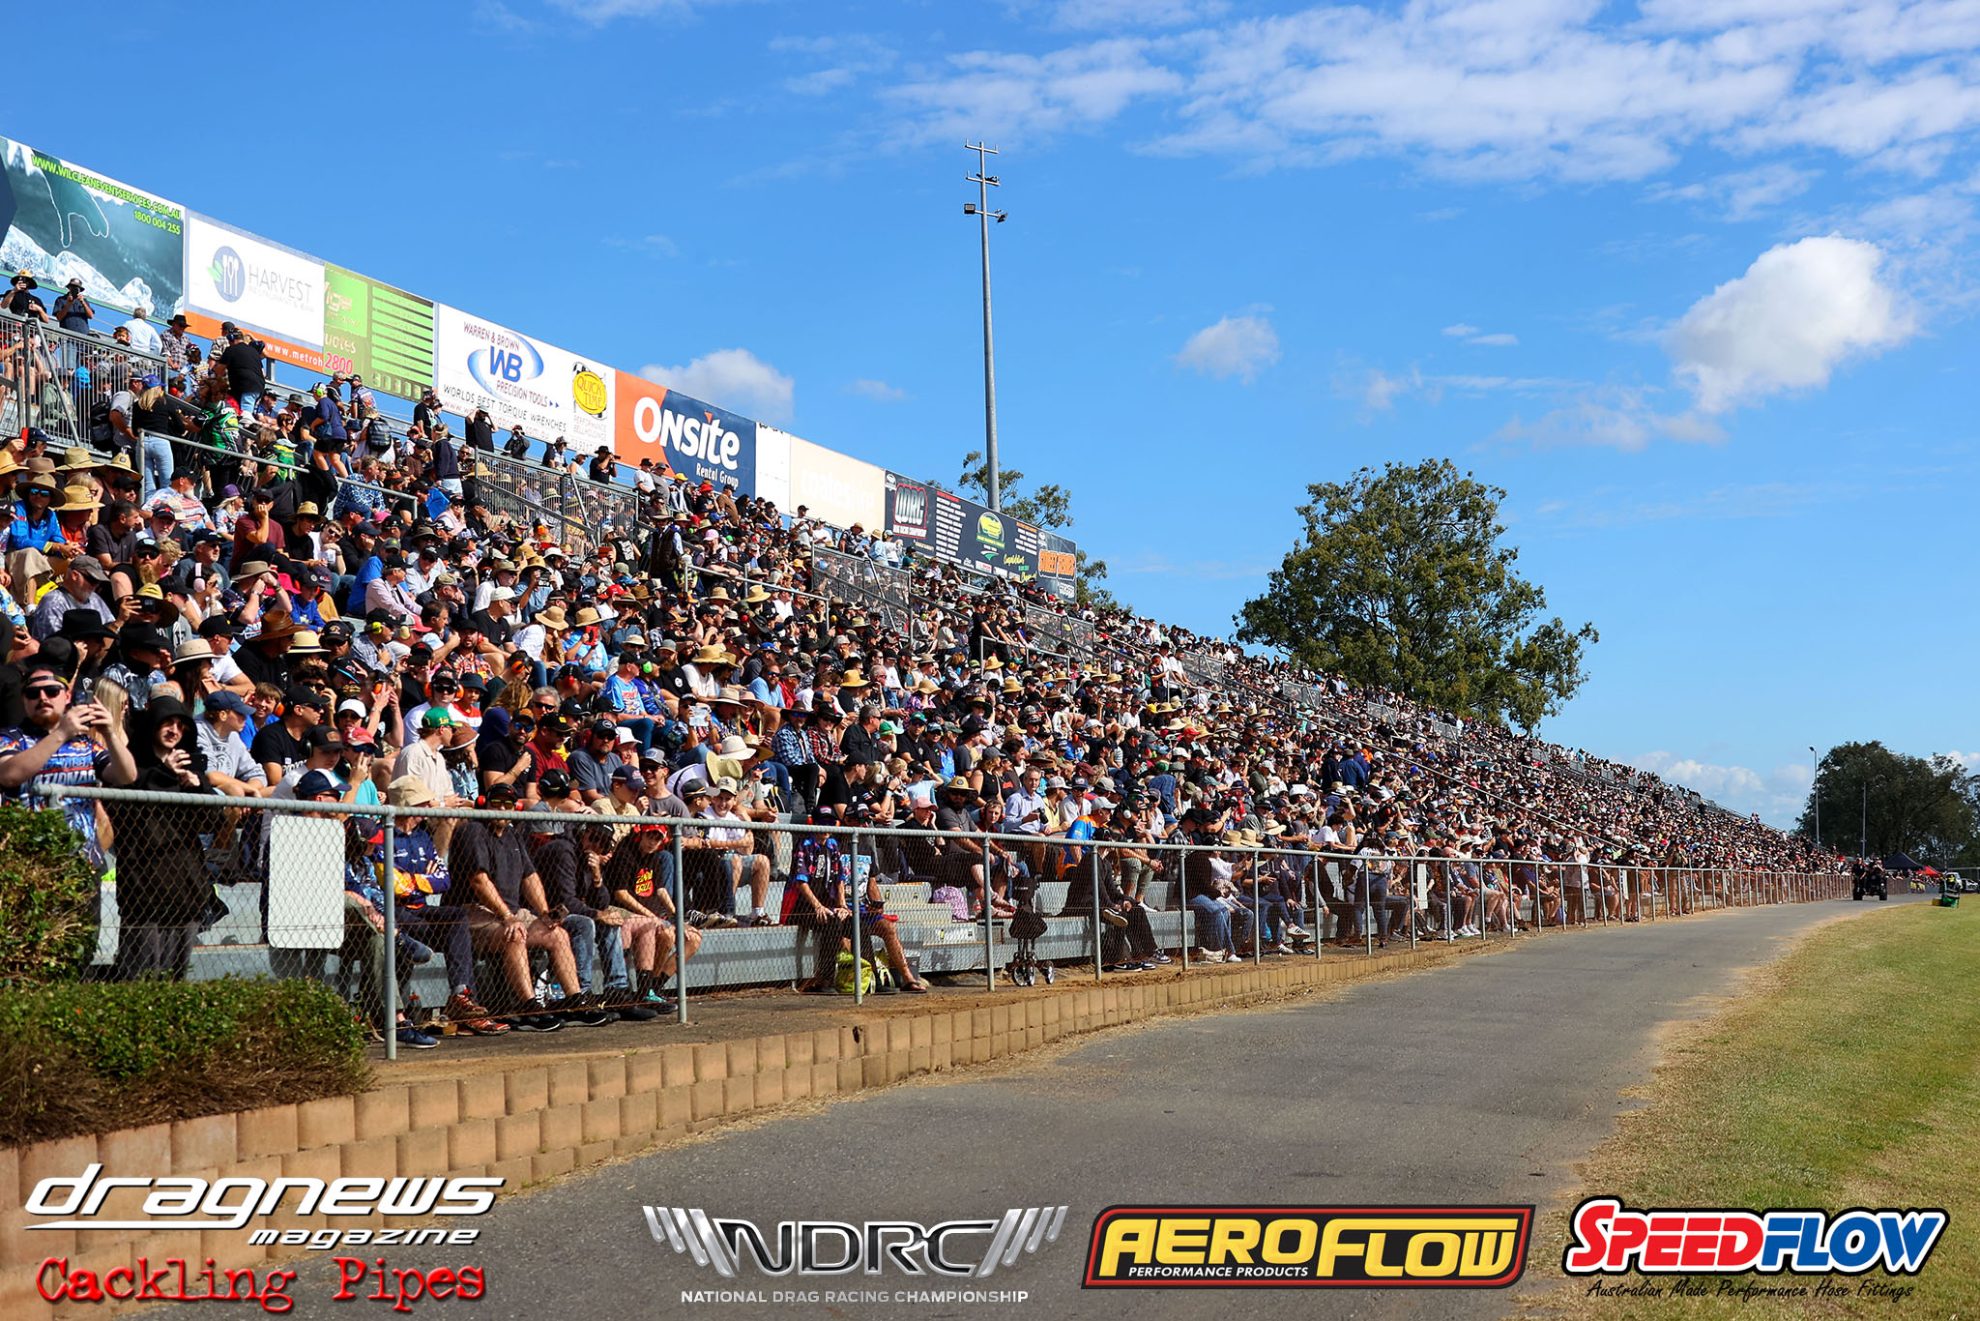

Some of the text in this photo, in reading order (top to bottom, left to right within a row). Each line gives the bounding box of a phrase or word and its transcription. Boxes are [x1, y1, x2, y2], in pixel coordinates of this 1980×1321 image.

[134, 210, 181, 235] 1800 004 255
[249, 264, 312, 304] HARVEST
[464, 321, 490, 340] WARREN
[497, 334, 520, 351] BROWN
[325, 352, 353, 375] 2800
[489, 345, 523, 383] WB
[443, 384, 475, 404] WORLDS
[477, 394, 496, 410] BEST
[498, 401, 527, 420] TORQUE
[530, 413, 567, 433] WRENCHES
[496, 380, 548, 408] PRECISION TOOLS
[696, 462, 739, 491] Rental Group
